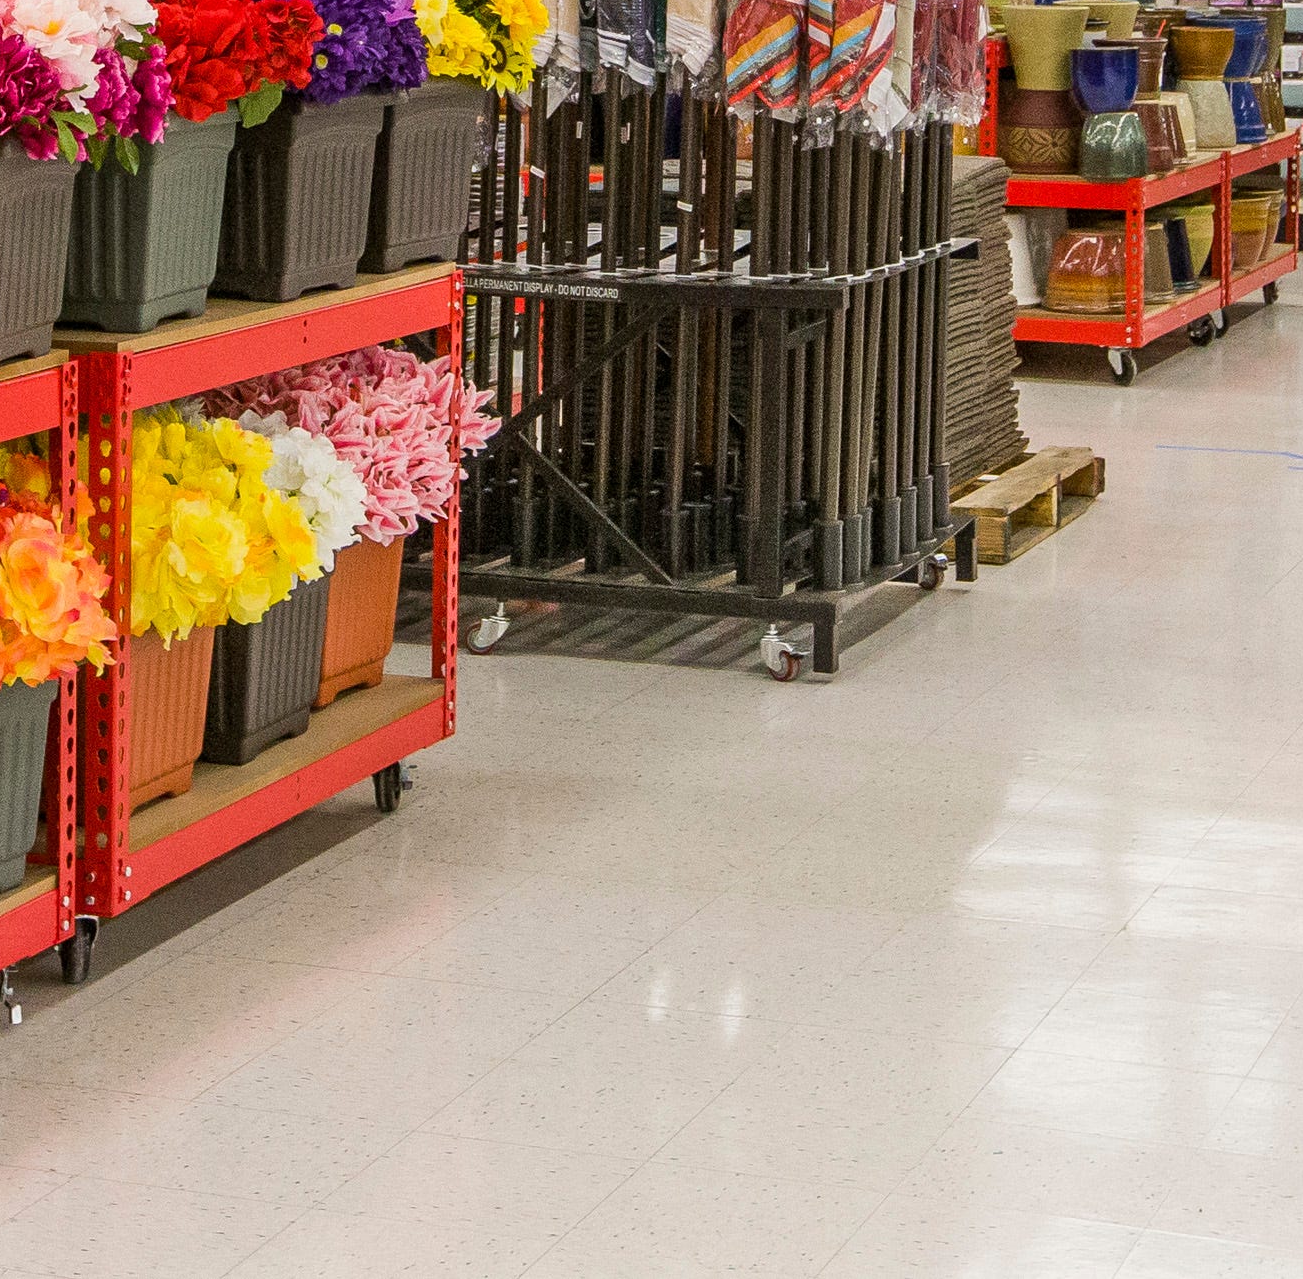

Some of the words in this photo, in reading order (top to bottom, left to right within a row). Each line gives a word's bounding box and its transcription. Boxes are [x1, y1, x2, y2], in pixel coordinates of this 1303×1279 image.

[479, 278, 523, 291] PERMANENT
[524, 282, 554, 294] DISPLAY
[558, 284, 570, 295] DO
[570, 285, 586, 297] NOT
[586, 286, 619, 300] DISCARD
